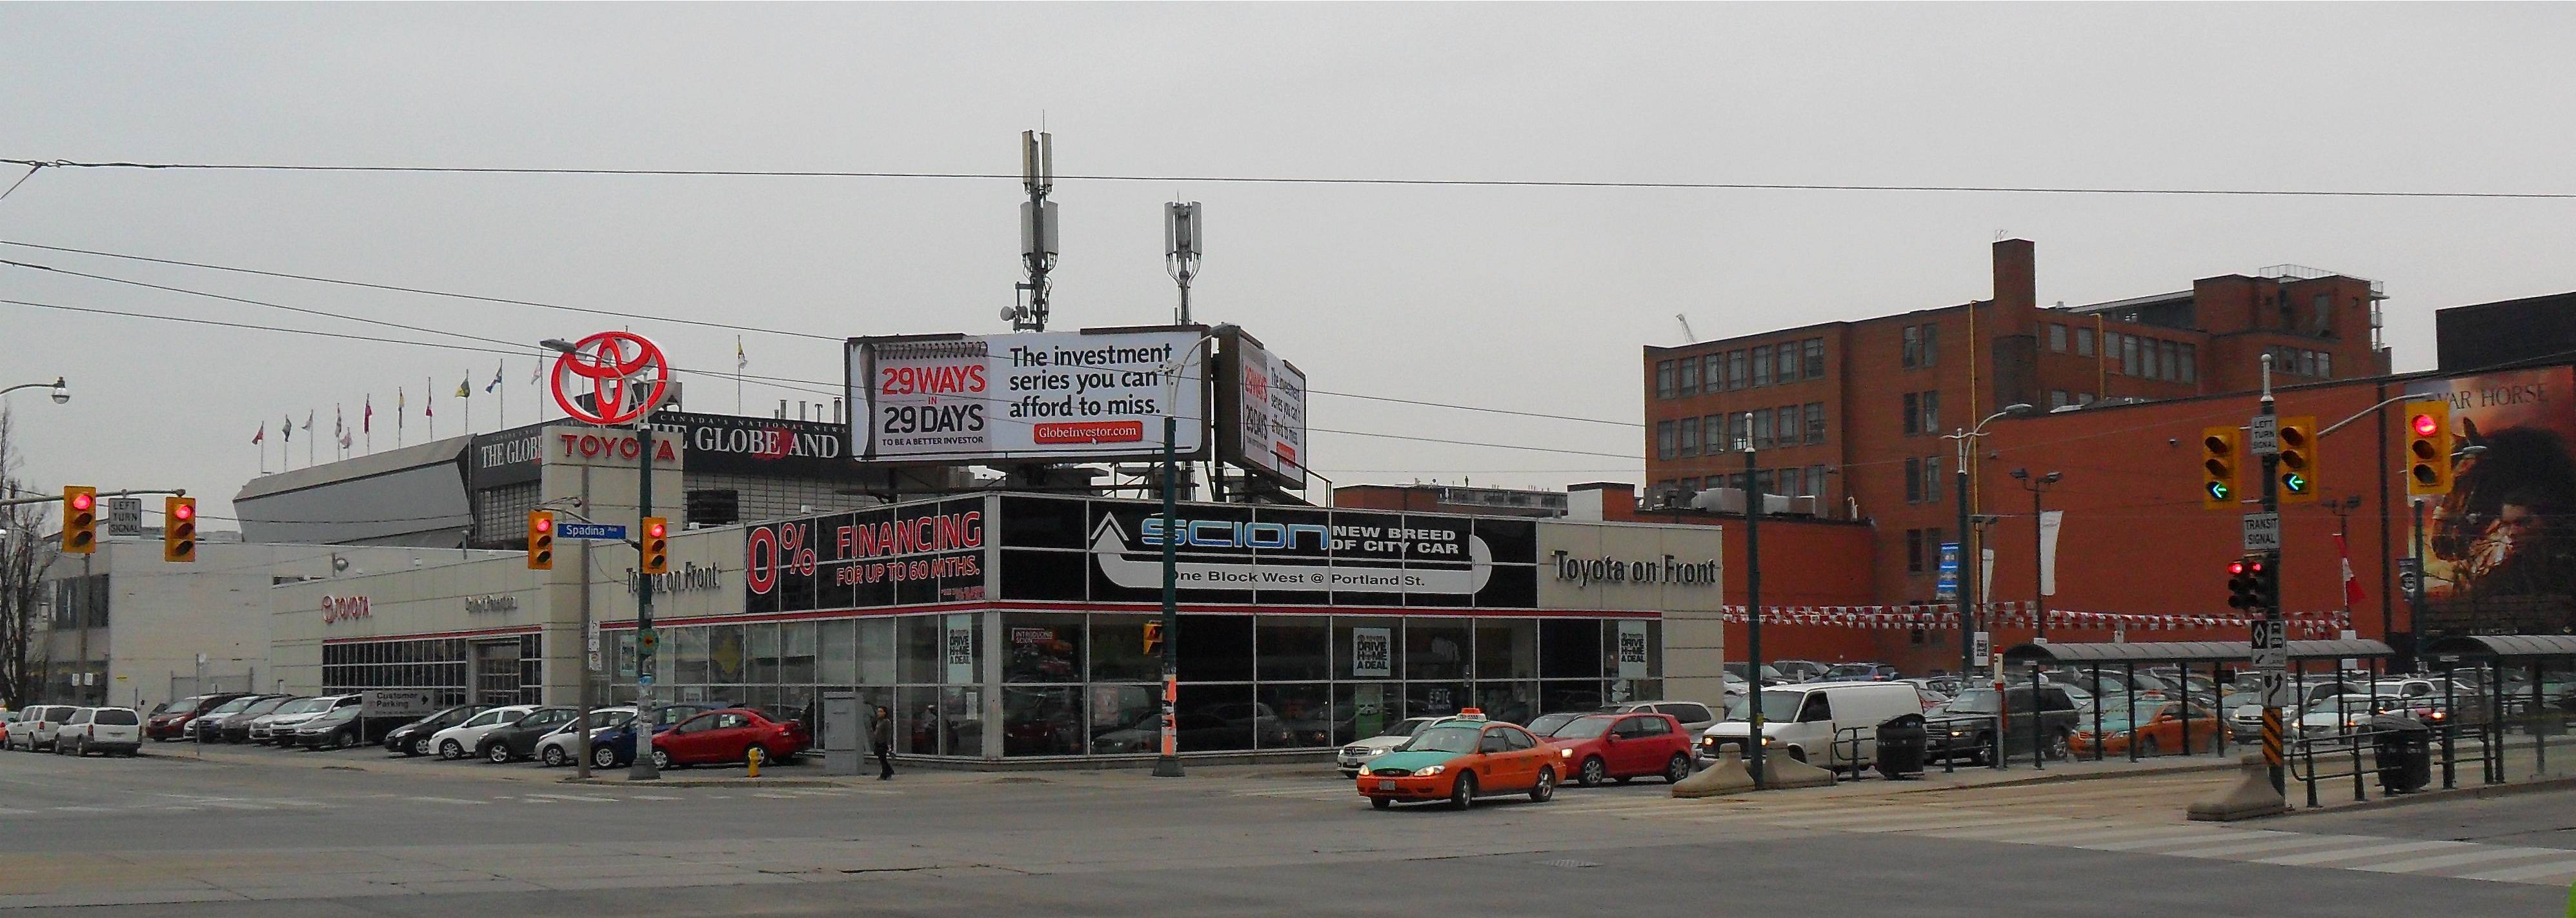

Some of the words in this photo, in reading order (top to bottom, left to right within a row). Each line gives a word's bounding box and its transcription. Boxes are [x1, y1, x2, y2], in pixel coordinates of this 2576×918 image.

[1010, 345, 1047, 367] The
[1054, 343, 1172, 367] investment
[882, 368, 914, 394] 29
[916, 365, 986, 394] WAYS
[1010, 369, 1070, 391] series
[1076, 372, 1115, 395] you
[928, 396, 937, 405] IN
[2480, 383, 2548, 408] HORSE
[1009, 394, 1072, 418] afford
[1078, 396, 1101, 416] to
[1108, 393, 1161, 415] miss.
[660, 414, 728, 425] CANADA'S
[738, 420, 805, 431] NATIONAL
[883, 405, 916, 433] 29
[920, 404, 985, 433] DAYS
[2254, 420, 2273, 429] LEFT
[1039, 426, 1137, 438] GlobeInvestor.com
[559, 433, 676, 461] TOYOA
[694, 427, 781, 454] GLOBE
[789, 433, 840, 459] AND
[913, 437, 942, 445] BETTER
[943, 436, 983, 444] INVESTOR
[481, 443, 504, 469] THE
[113, 501, 135, 510] LEFT
[113, 513, 137, 521] TURN
[2246, 518, 2277, 530] TRANSIT
[110, 524, 139, 533] SIGNAL
[566, 525, 605, 538] Spadina
[1332, 525, 1381, 537] NEW
[1388, 528, 1456, 540] BREED
[1330, 539, 1357, 550] OF
[1363, 540, 1411, 553] CITY
[1417, 543, 1459, 554] CAR
[2248, 534, 2275, 545] SIGNAL
[748, 522, 816, 595] 0%
[836, 511, 981, 560] FINANCING
[836, 567, 863, 586] FOR
[865, 564, 885, 583] UP
[887, 561, 907, 581] TO
[910, 560, 928, 580] 60
[1551, 550, 1625, 587] Toyota
[1630, 560, 1657, 582] on
[1661, 554, 1716, 584] Front
[626, 567, 666, 594] Tota
[667, 570, 681, 591] on
[685, 561, 720, 589] Front
[1175, 571, 1202, 581] ne
[1208, 571, 1259, 582] Block
[1262, 572, 1305, 584] West
[1331, 574, 1399, 586] Portland
[1404, 576, 1425, 587] St.
[1357, 641, 1387, 651] DRIVE
[1356, 660, 1363, 669] A
[1365, 660, 1388, 669] DEAL
[376, 700, 408, 709] Parking
